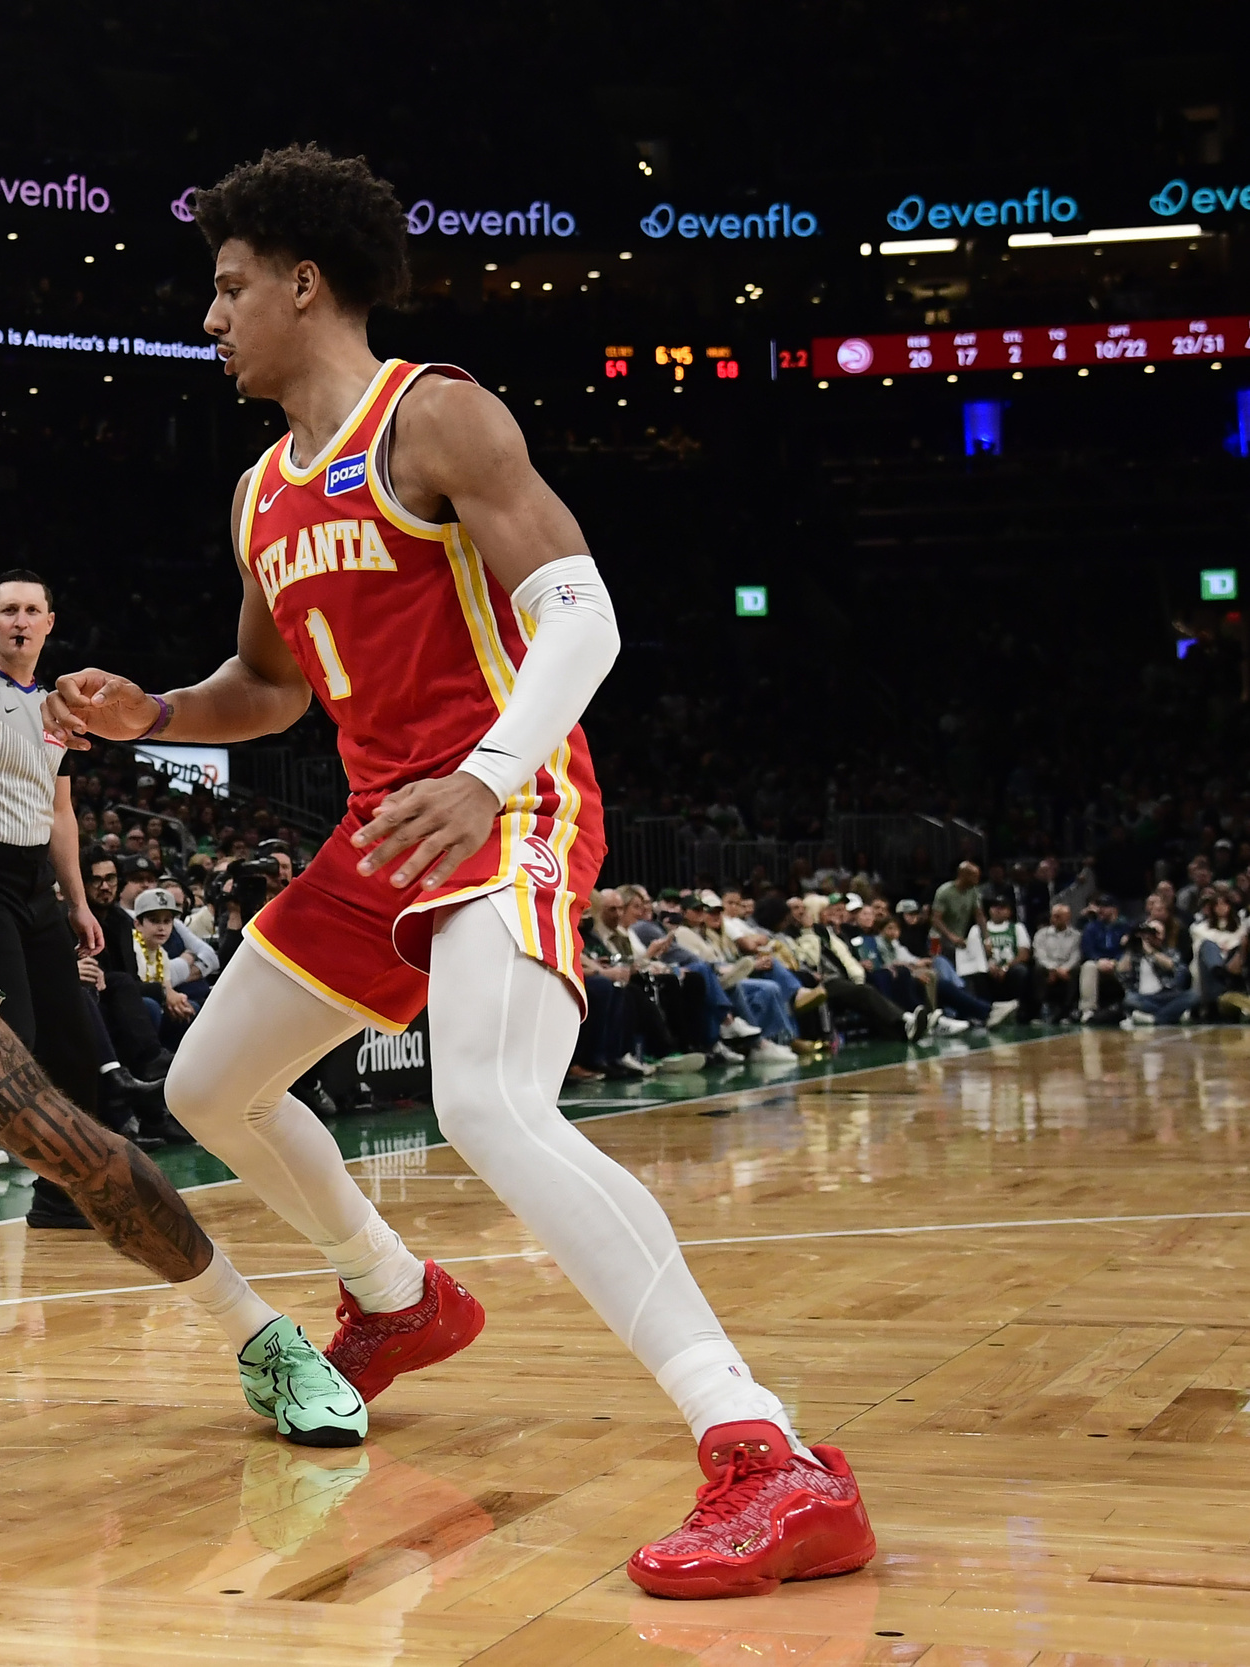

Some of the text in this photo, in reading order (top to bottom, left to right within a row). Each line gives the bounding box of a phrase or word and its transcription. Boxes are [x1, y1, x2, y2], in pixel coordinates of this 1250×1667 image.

[437, 200, 576, 237] evenflo
[677, 202, 818, 239] evenflo
[927, 187, 1078, 230] evenflo
[8, 328, 22, 346] is
[24, 329, 105, 353] America's
[107, 336, 130, 354] #1
[134, 338, 215, 361] Rotational
[908, 333, 1225, 368] 20 17 2 4 10/22 23/51
[330, 461, 365, 487] paze
[305, 608, 351, 700] 1
[356, 1026, 425, 1075] Amica
